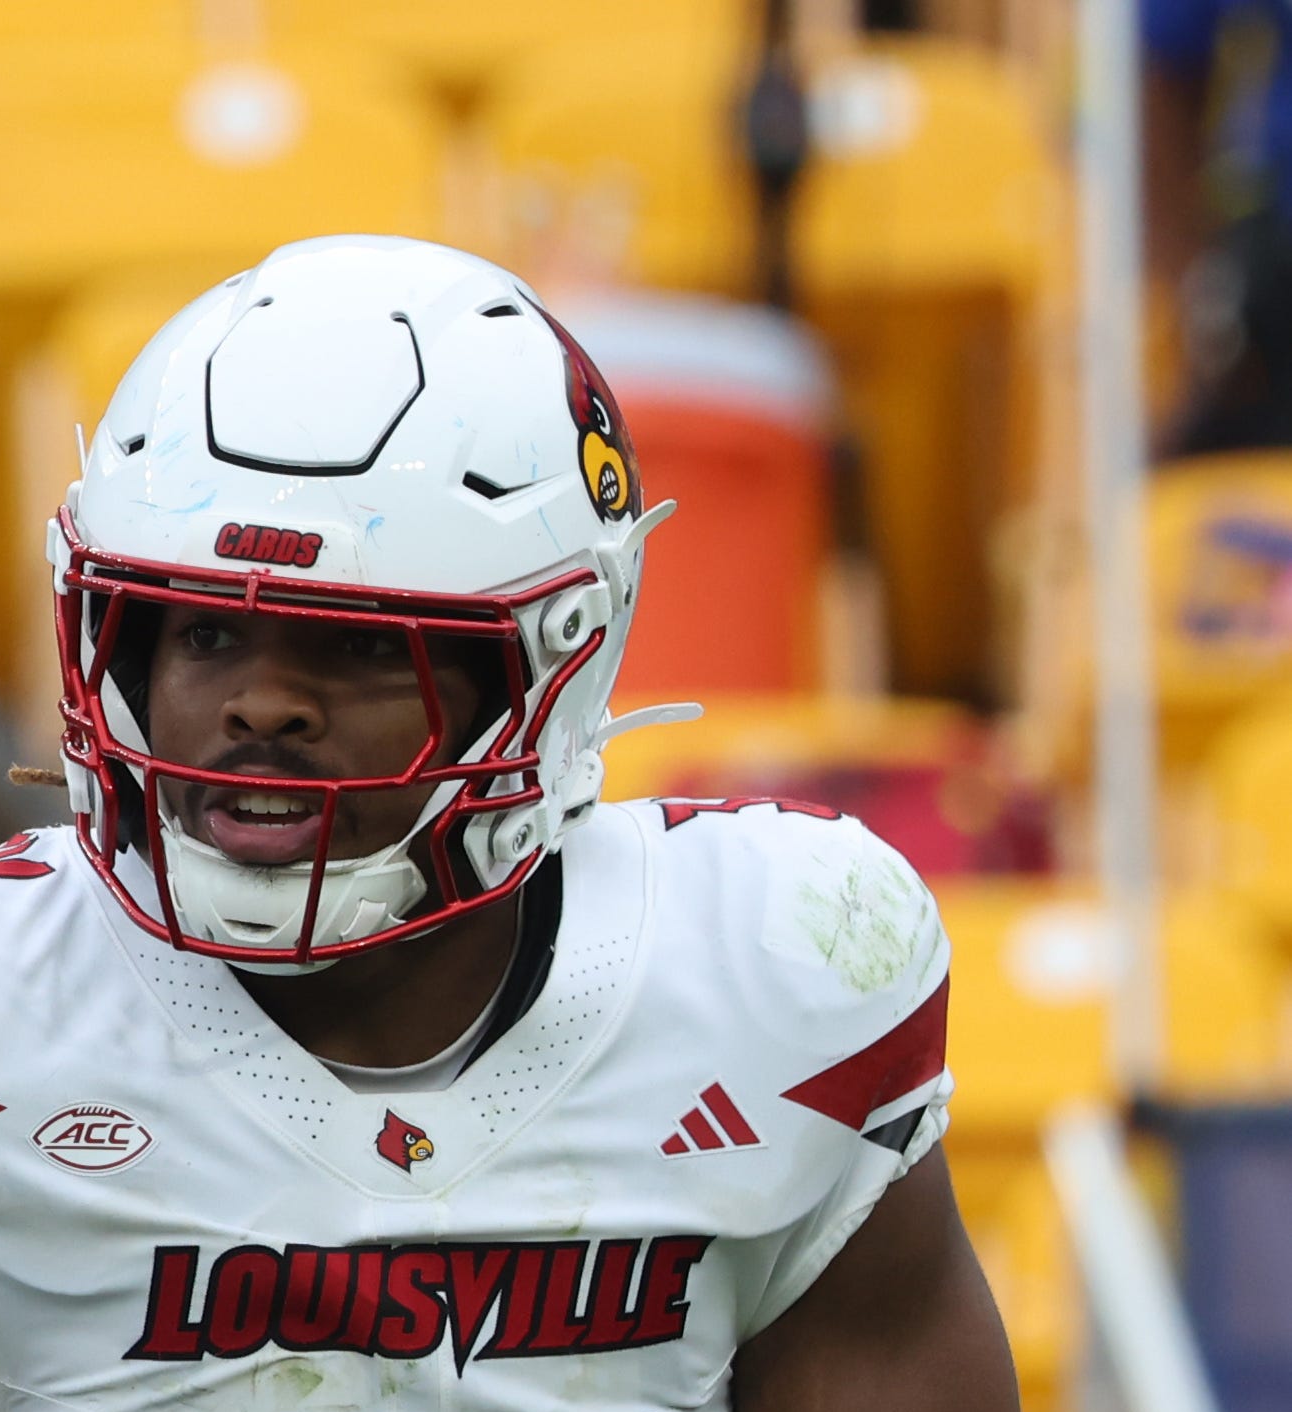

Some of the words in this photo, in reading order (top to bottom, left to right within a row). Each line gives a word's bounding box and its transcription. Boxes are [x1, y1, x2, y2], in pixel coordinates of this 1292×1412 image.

[214, 522, 324, 568] CARDS
[52, 1121, 136, 1147] ACC
[121, 1234, 717, 1380] LOUISVILLE
